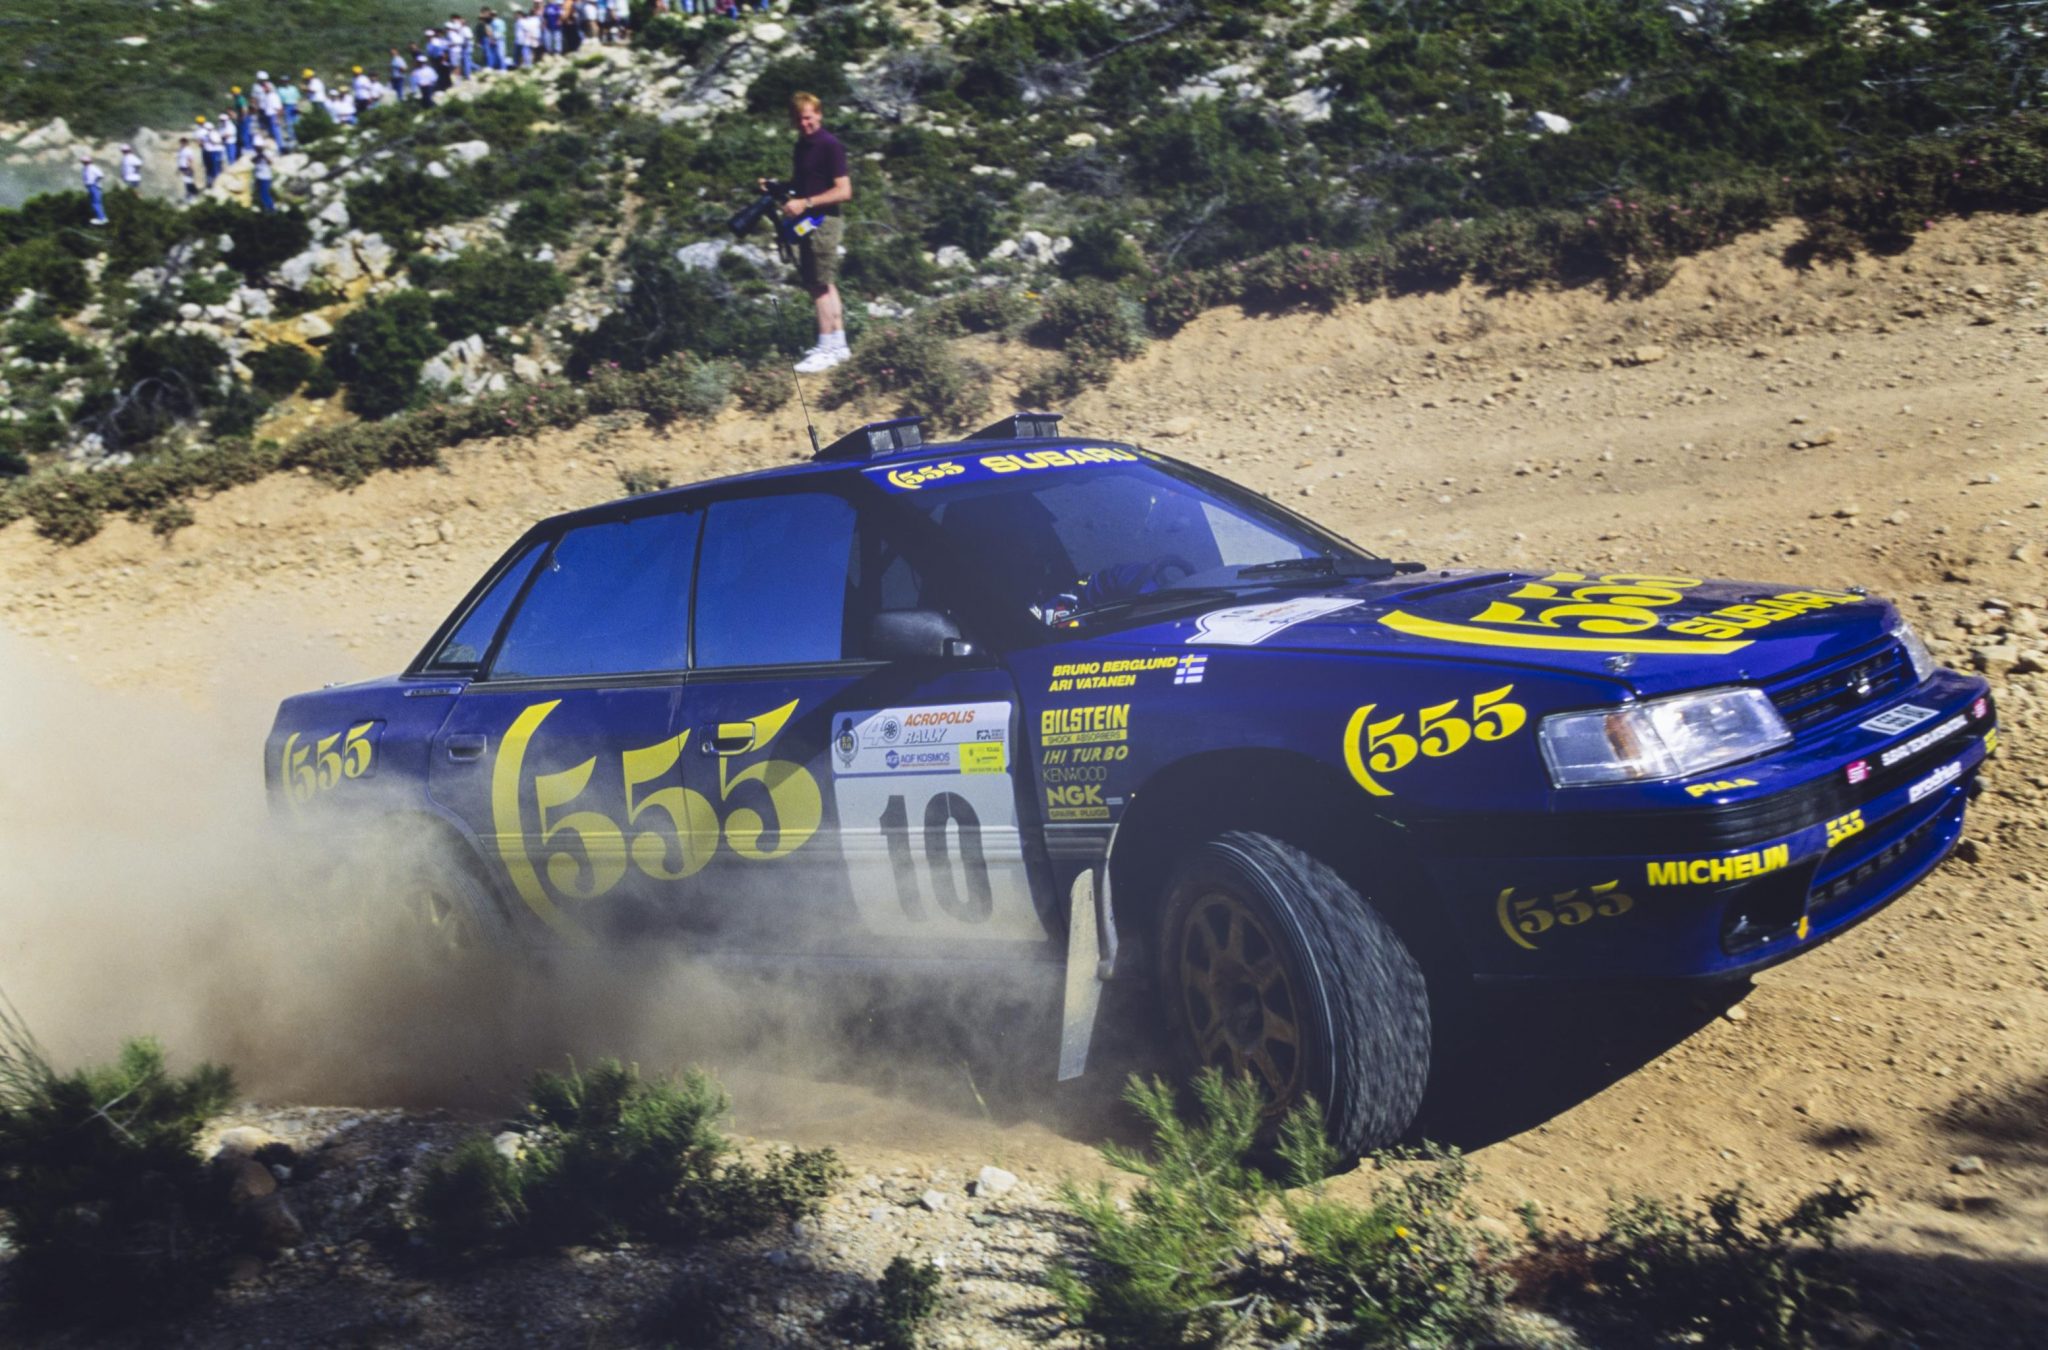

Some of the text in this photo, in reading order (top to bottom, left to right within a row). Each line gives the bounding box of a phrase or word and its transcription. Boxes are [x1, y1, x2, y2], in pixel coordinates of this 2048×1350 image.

[979, 447, 1138, 473] SUBARU
[1666, 588, 1866, 639] SUBARU
[1052, 656, 1178, 677] BRUNO BERGLUND
[1049, 674, 1136, 692] ARI VATANEN
[904, 710, 976, 727] ACROPOLIS
[1041, 704, 1130, 734] BILSTEIN
[905, 728, 947, 744] RALLY
[1048, 734, 1072, 744] SHOCK
[917, 752, 950, 763] KOSMOS
[1043, 745, 1129, 764] IHI TURBO
[1043, 766, 1107, 782] KENWOOD
[1046, 784, 1103, 806] NGK
[879, 791, 993, 925] 10
[1646, 844, 1789, 886] MICHELIN
